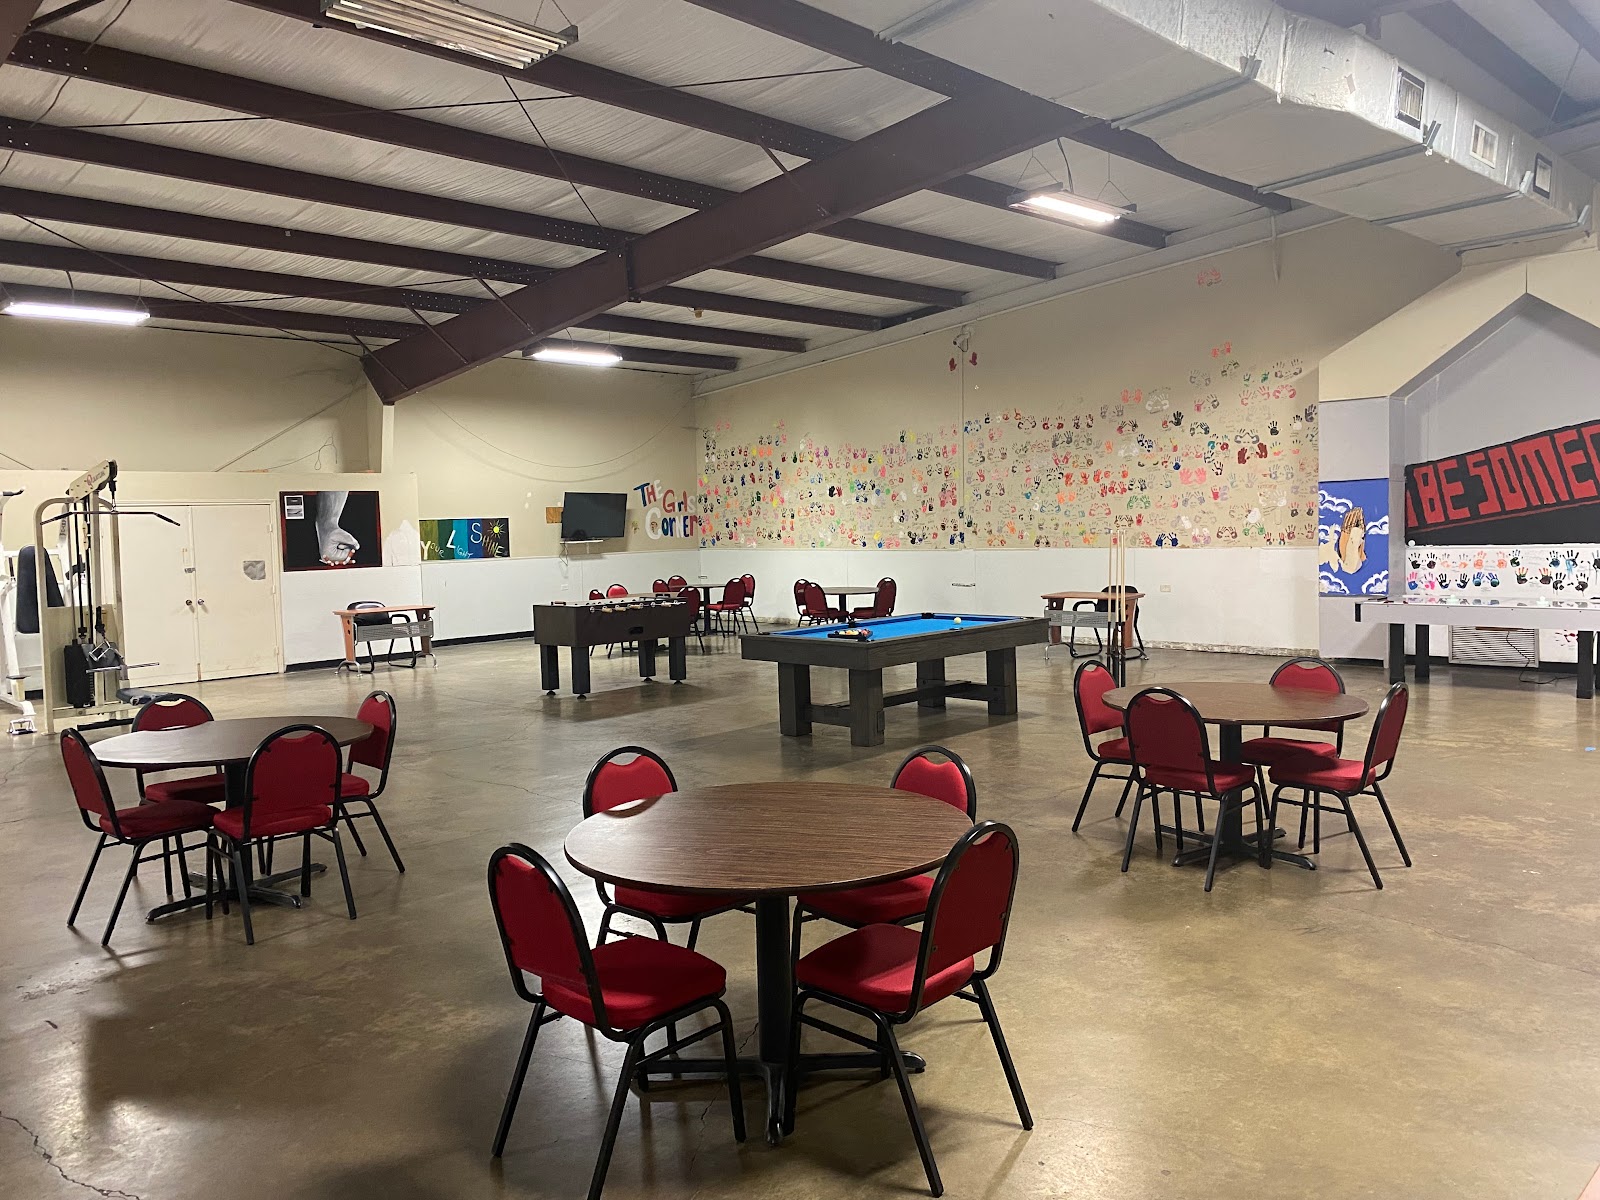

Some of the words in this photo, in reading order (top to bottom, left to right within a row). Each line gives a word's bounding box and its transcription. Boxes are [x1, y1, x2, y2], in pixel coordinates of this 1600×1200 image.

[633, 479, 664, 507] THE
[1413, 459, 1471, 524] BE
[470, 522, 505, 558] SHINE
